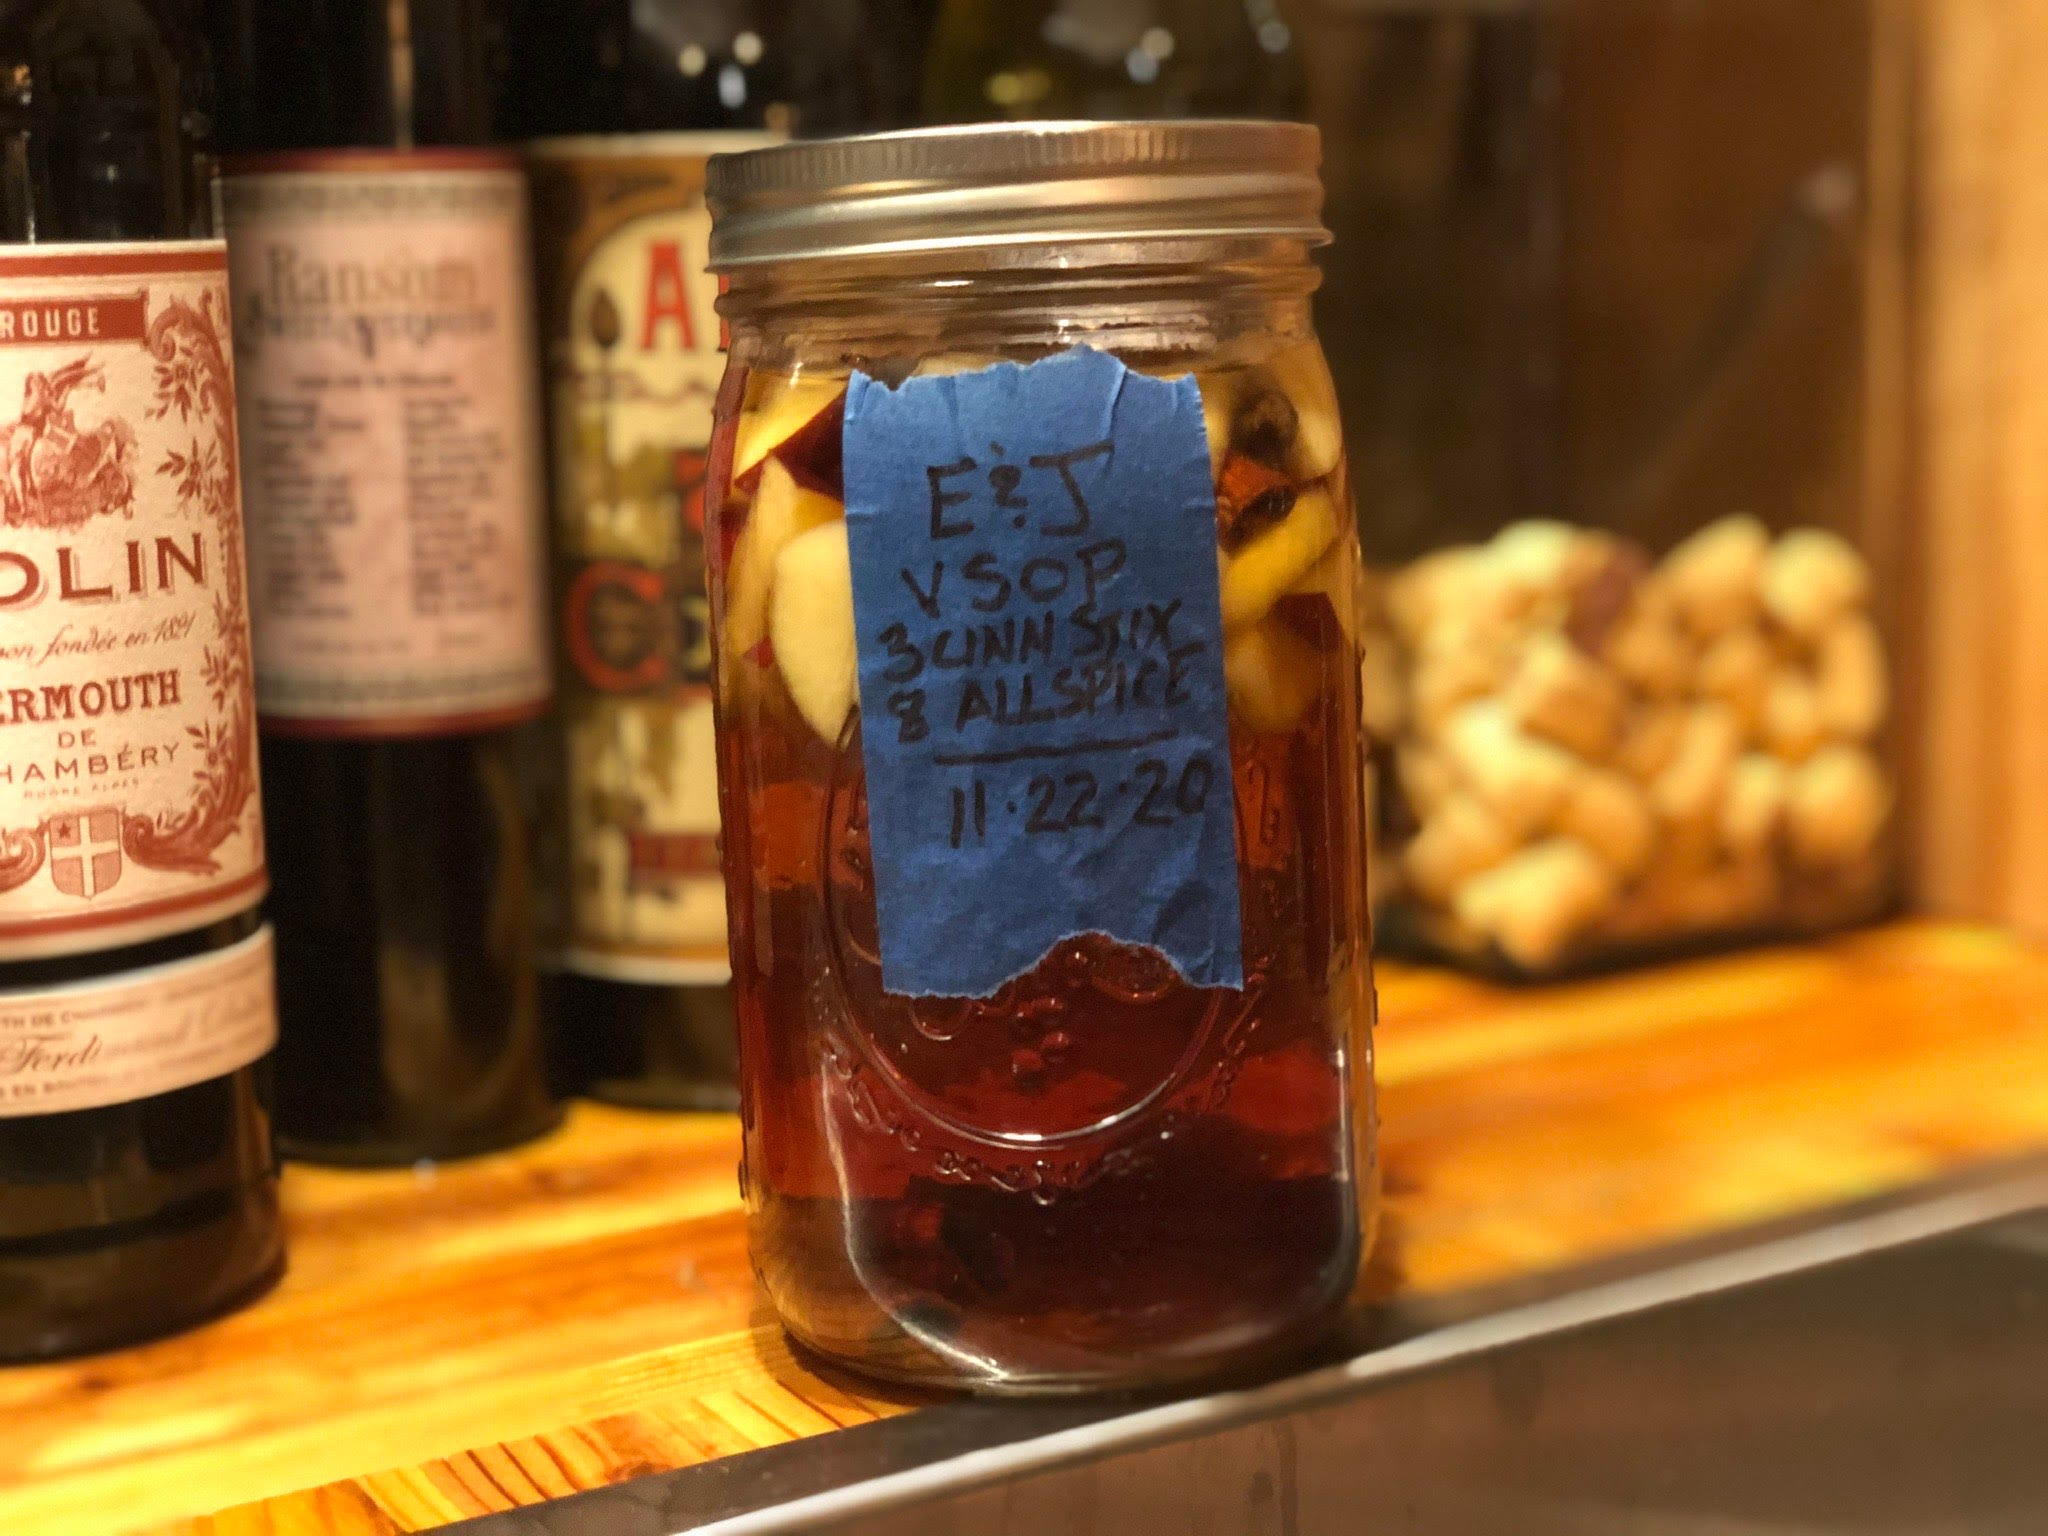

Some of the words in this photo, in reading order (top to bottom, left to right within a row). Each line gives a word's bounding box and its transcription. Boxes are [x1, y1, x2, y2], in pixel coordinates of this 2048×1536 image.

[926, 439, 1115, 540] E&J
[900, 537, 1127, 619] VSOP
[876, 620, 926, 684] 3
[932, 609, 1056, 670] CINN
[1069, 598, 1183, 660] STIX
[0, 668, 182, 726] RMOUTH
[886, 687, 931, 743] 8
[57, 729, 97, 749] DE
